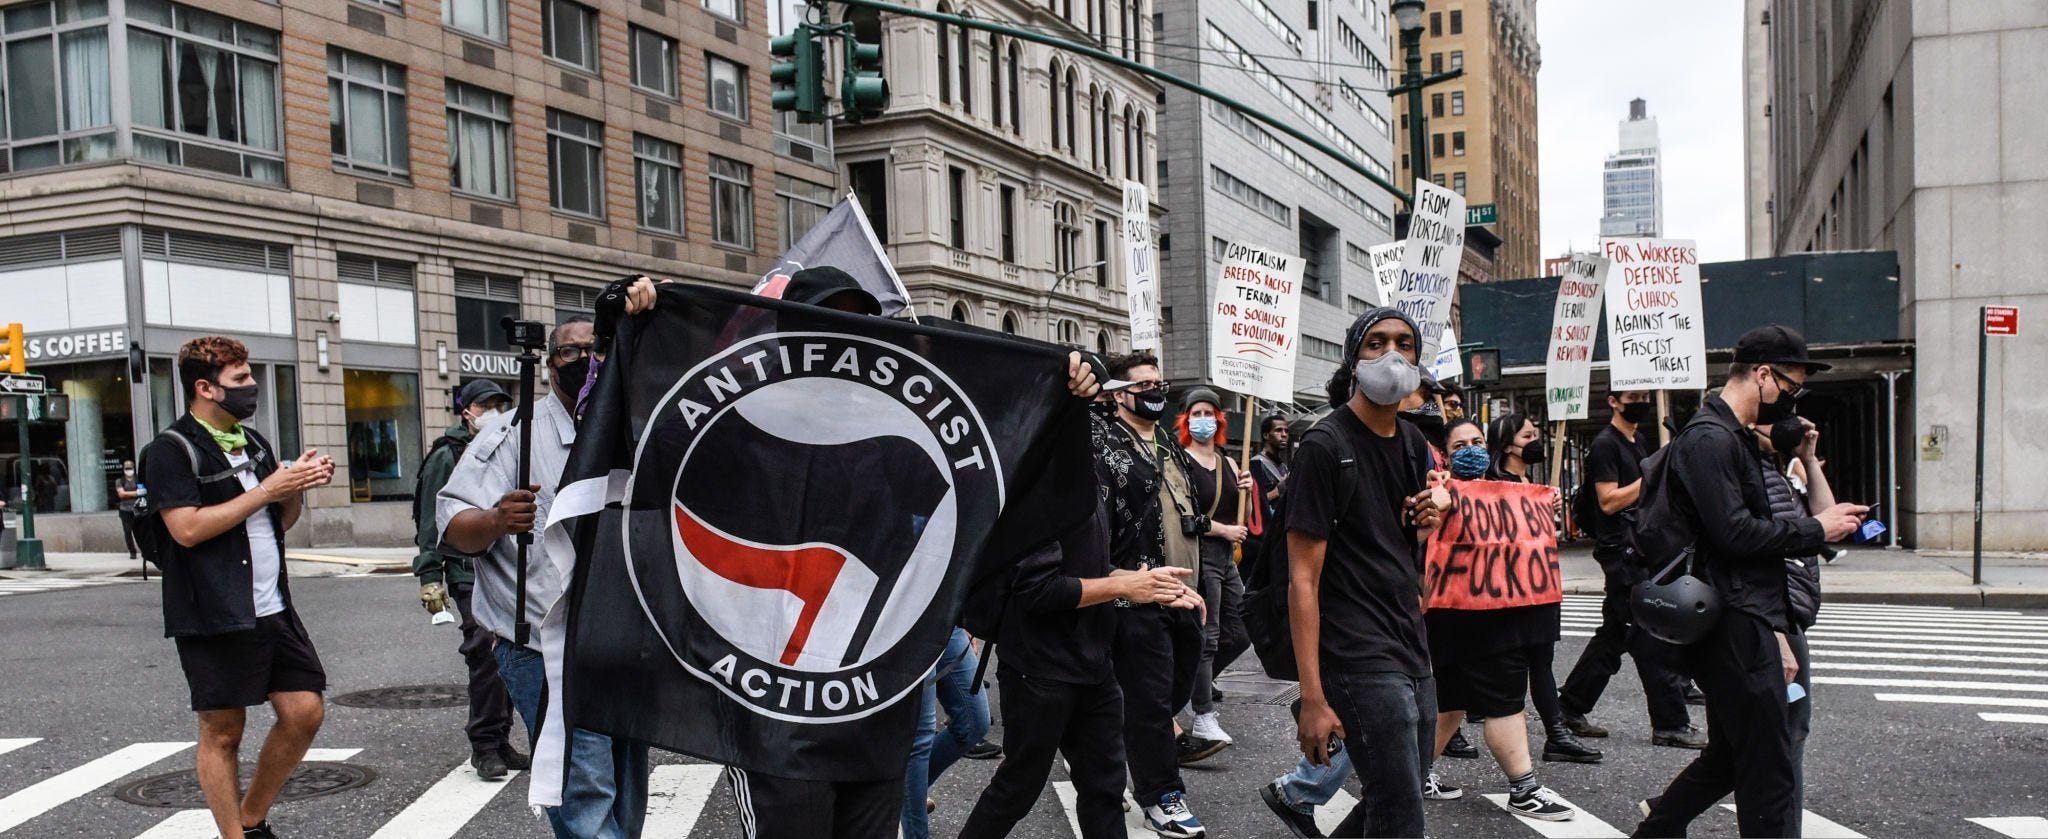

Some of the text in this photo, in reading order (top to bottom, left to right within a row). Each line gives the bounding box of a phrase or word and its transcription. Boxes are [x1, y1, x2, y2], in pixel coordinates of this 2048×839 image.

[1421, 189, 1450, 218] FROM
[1411, 214, 1455, 245] PORTLAND
[1133, 247, 1148, 275] OUT
[1229, 243, 1286, 272] CAPITALISM
[1421, 245, 1443, 267] NYC
[1606, 241, 1696, 265] FOR WORKERS
[1224, 266, 1293, 294] BREEDS RACIST
[1399, 268, 1451, 297] DEMOCRATS
[1624, 266, 1682, 285] DEFENSE
[1236, 286, 1279, 309] TERROR!
[1397, 298, 1436, 319] PROTECT
[1628, 288, 1679, 311] GUARDS
[1218, 302, 1288, 329] FOR SOCIALIST
[1615, 312, 1691, 334] AGAINST THE
[46, 331, 124, 357] COFFEE
[1622, 337, 1674, 357] FASCIST
[1222, 360, 1261, 373] REVOLUTIONARY
[1650, 355, 1692, 372] THREAT
[4, 380, 40, 388] ONE WAY
[1219, 369, 1264, 383] INTERNATIONALIST
[1229, 378, 1246, 387] YOUTH
[1613, 376, 1690, 387] INTERNATIONALIST GROUP
[677, 343, 985, 473] ANTIFASCIST
[1438, 486, 1518, 543] PROUD
[1438, 543, 1559, 598] FUCK OF
[709, 653, 880, 711] ACTION
